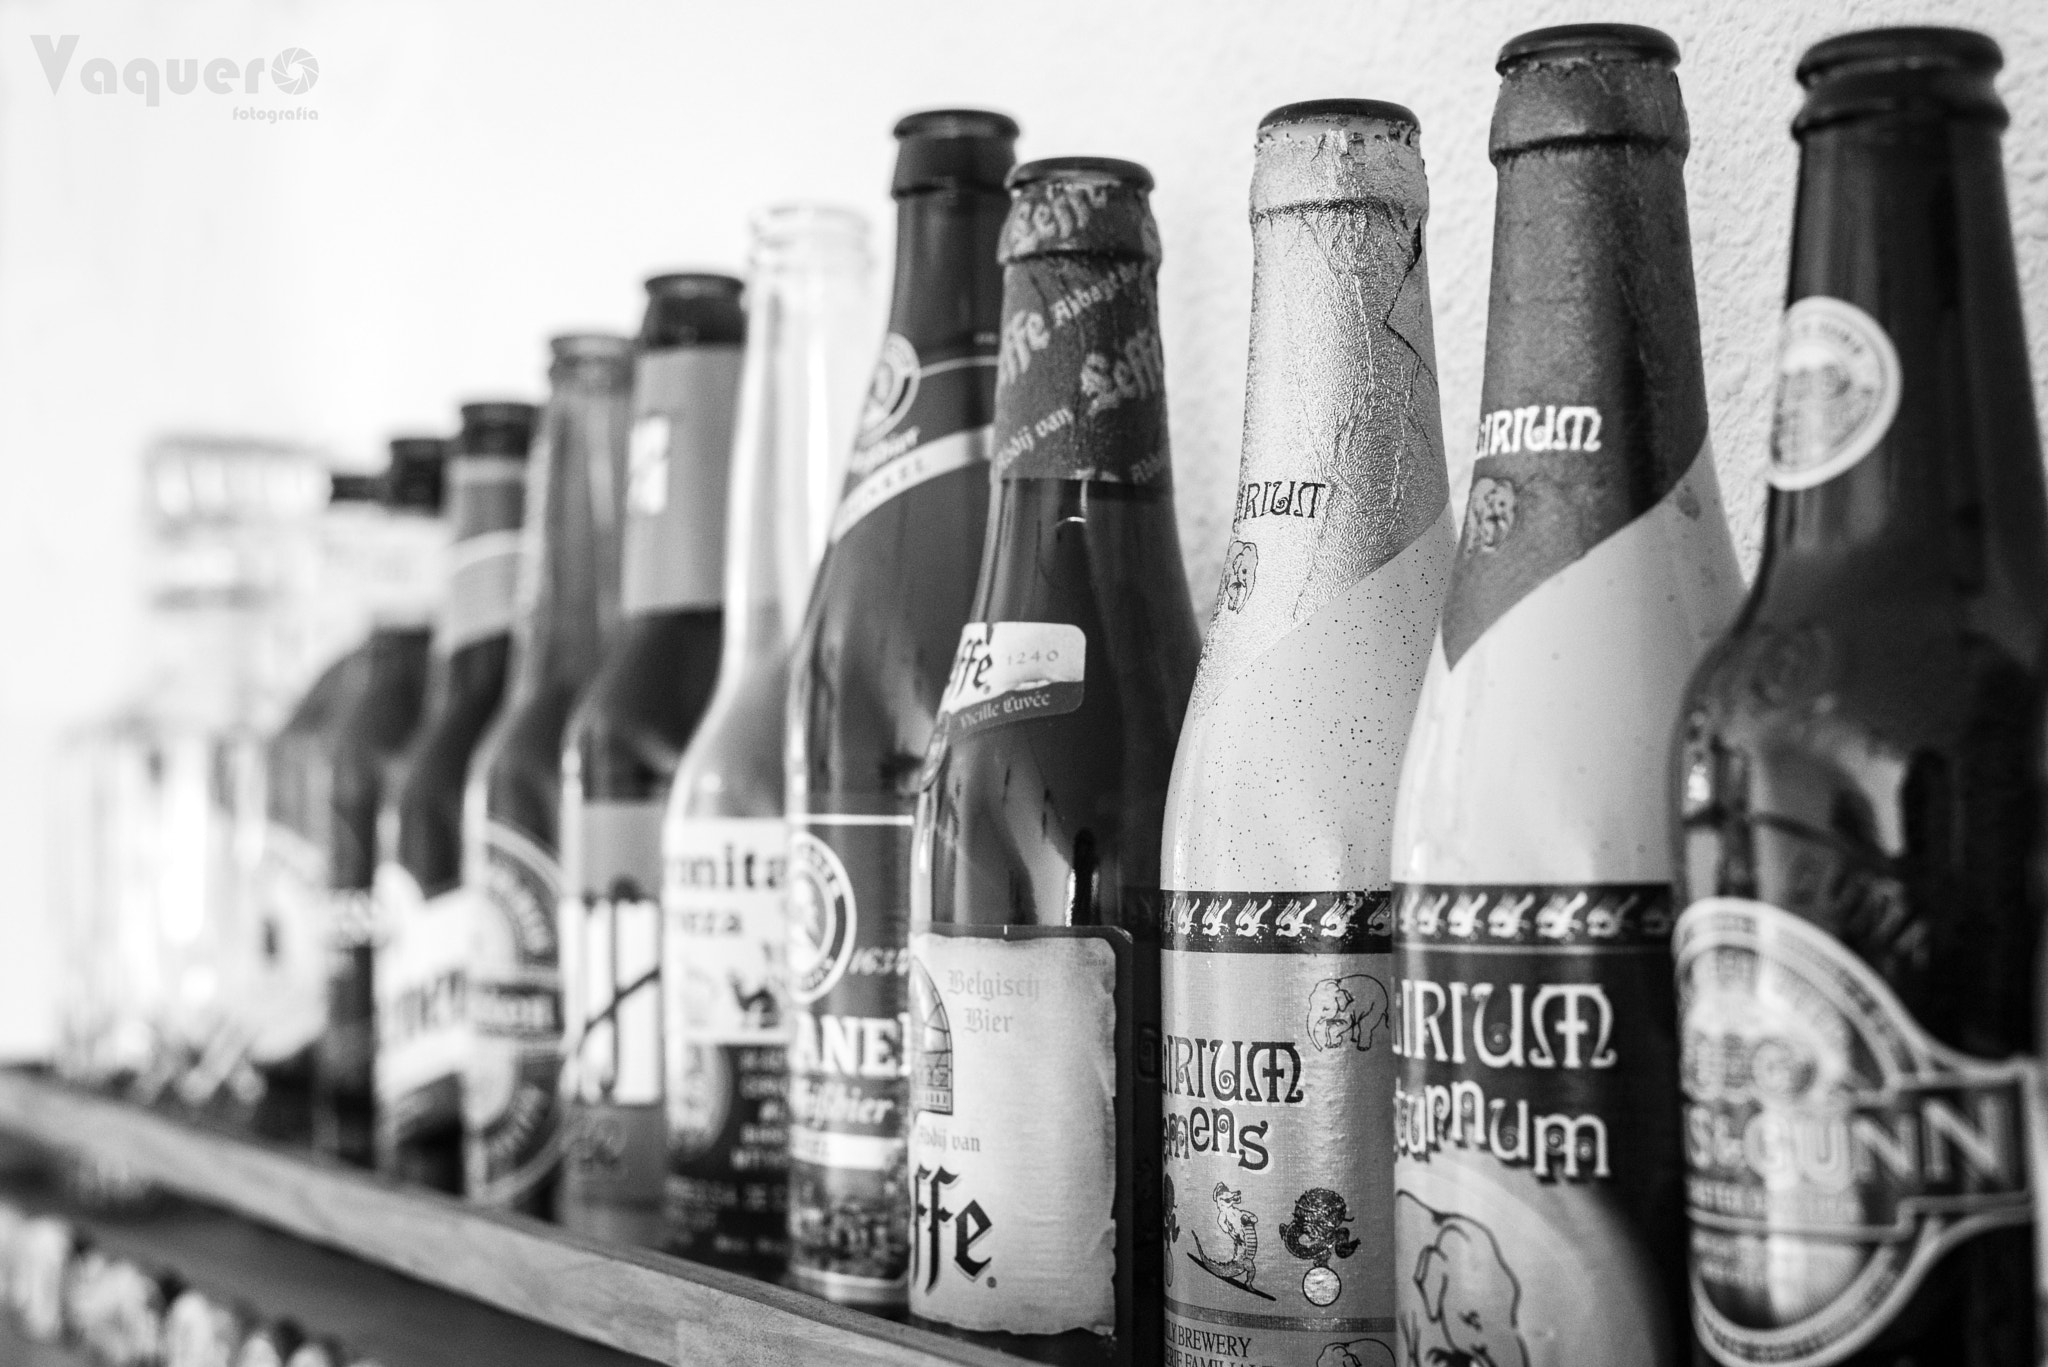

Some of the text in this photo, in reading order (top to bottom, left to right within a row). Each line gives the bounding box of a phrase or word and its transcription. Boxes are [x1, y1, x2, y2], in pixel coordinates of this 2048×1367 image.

[964, 1008, 1014, 1034] Bier
[952, 1135, 981, 1152] van
[1178, 1324, 1252, 1358] BREWERY
